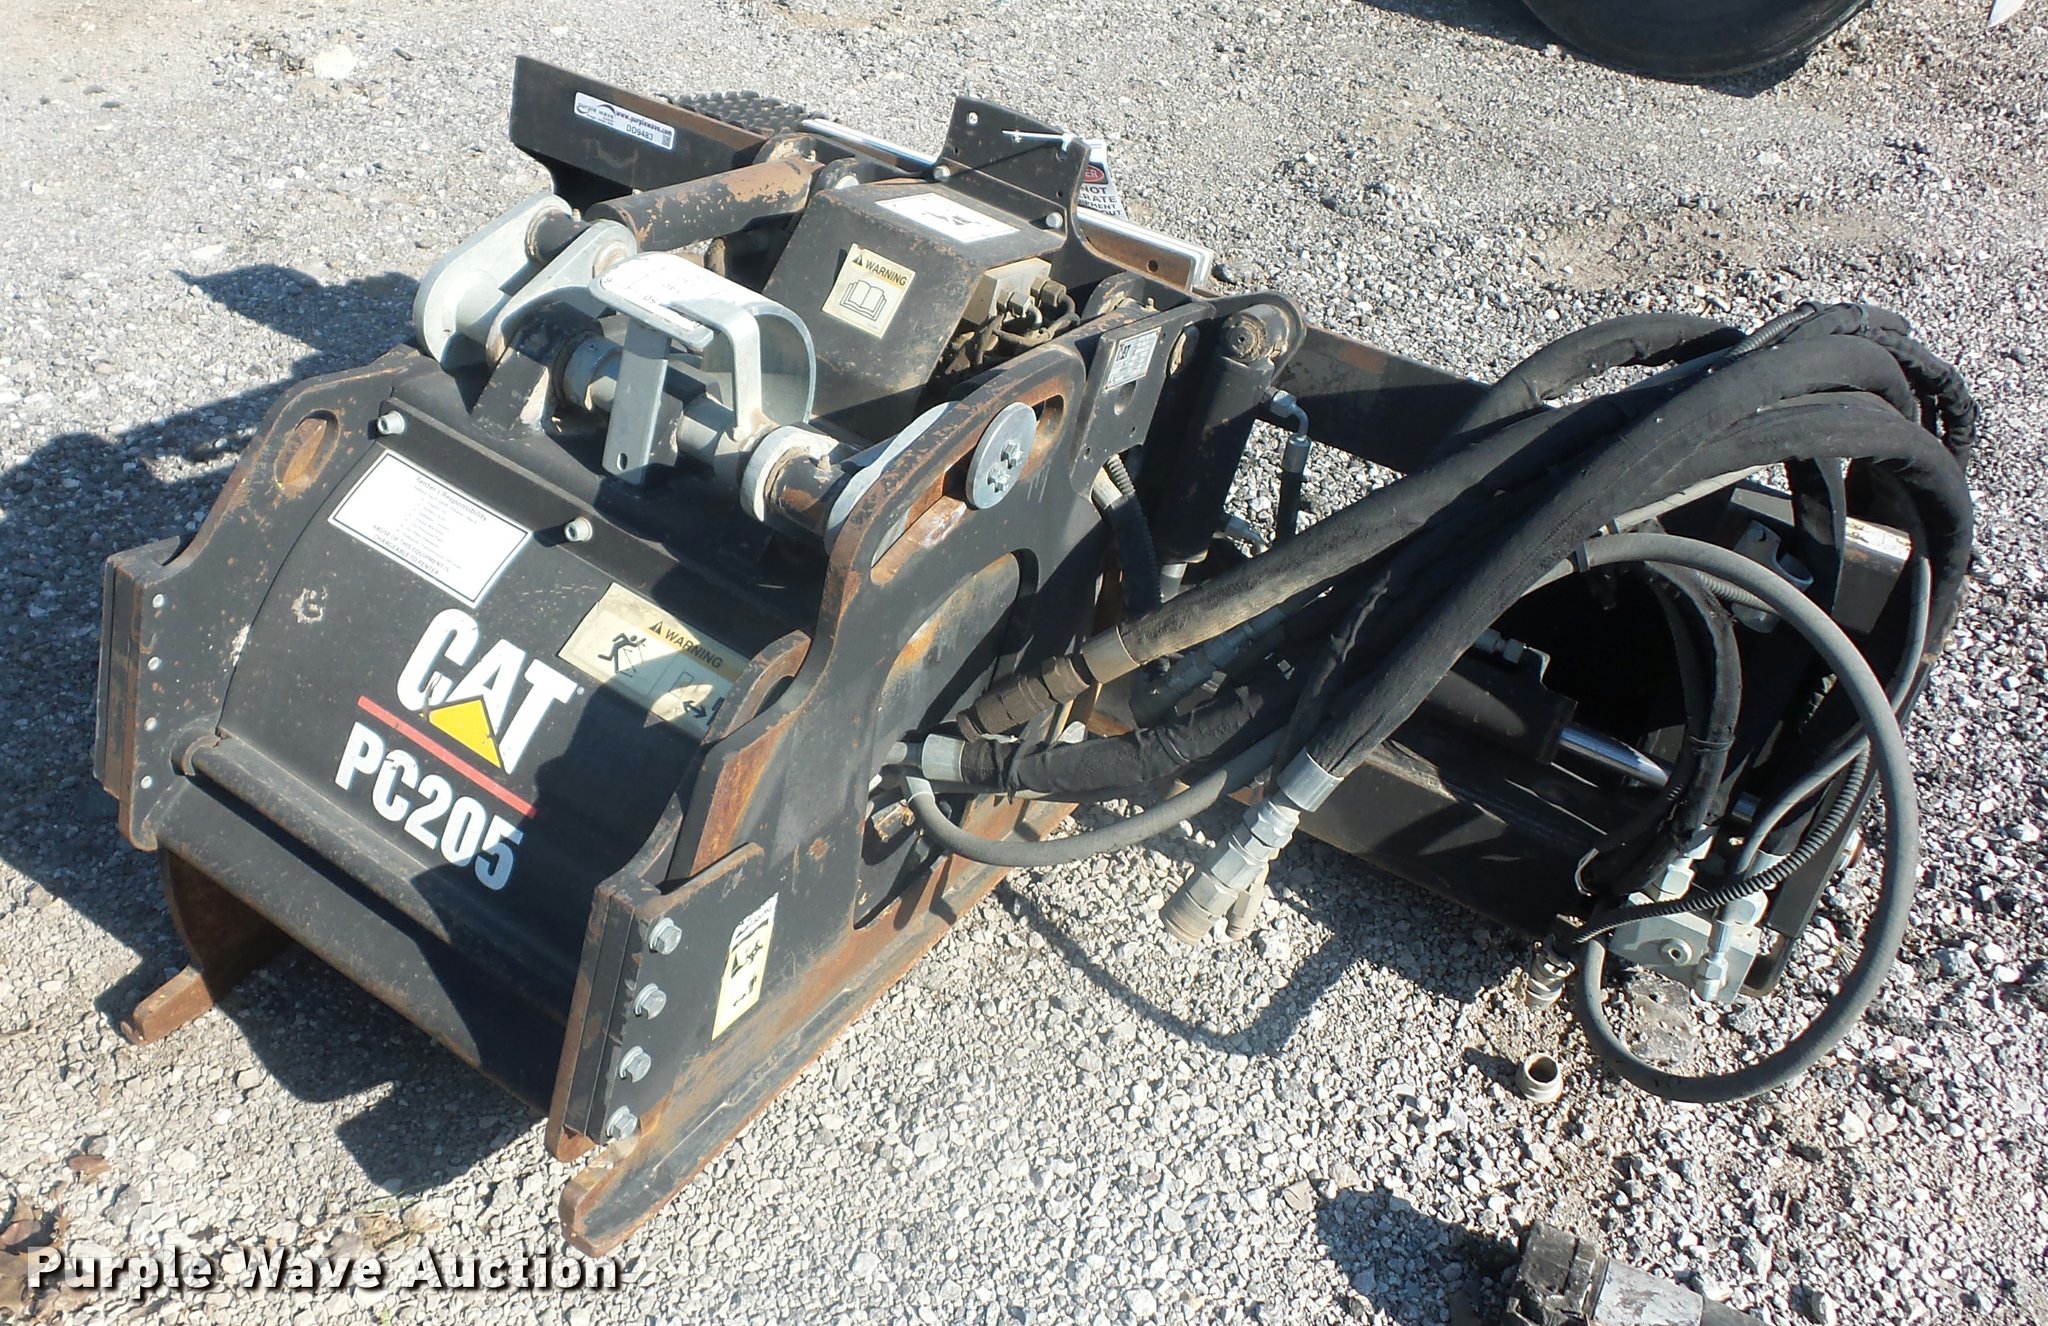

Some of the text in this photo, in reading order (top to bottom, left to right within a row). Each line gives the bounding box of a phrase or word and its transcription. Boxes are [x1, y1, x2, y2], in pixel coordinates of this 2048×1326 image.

[616, 111, 672, 136] www.purplewave.com
[626, 124, 654, 141] DD9483
[865, 259, 908, 286] WARNING
[441, 491, 487, 521] Responsibility
[416, 559, 439, 575] RENTER
[665, 629, 724, 669] WARNING
[396, 608, 578, 775] CAT
[335, 721, 523, 891] PC205
